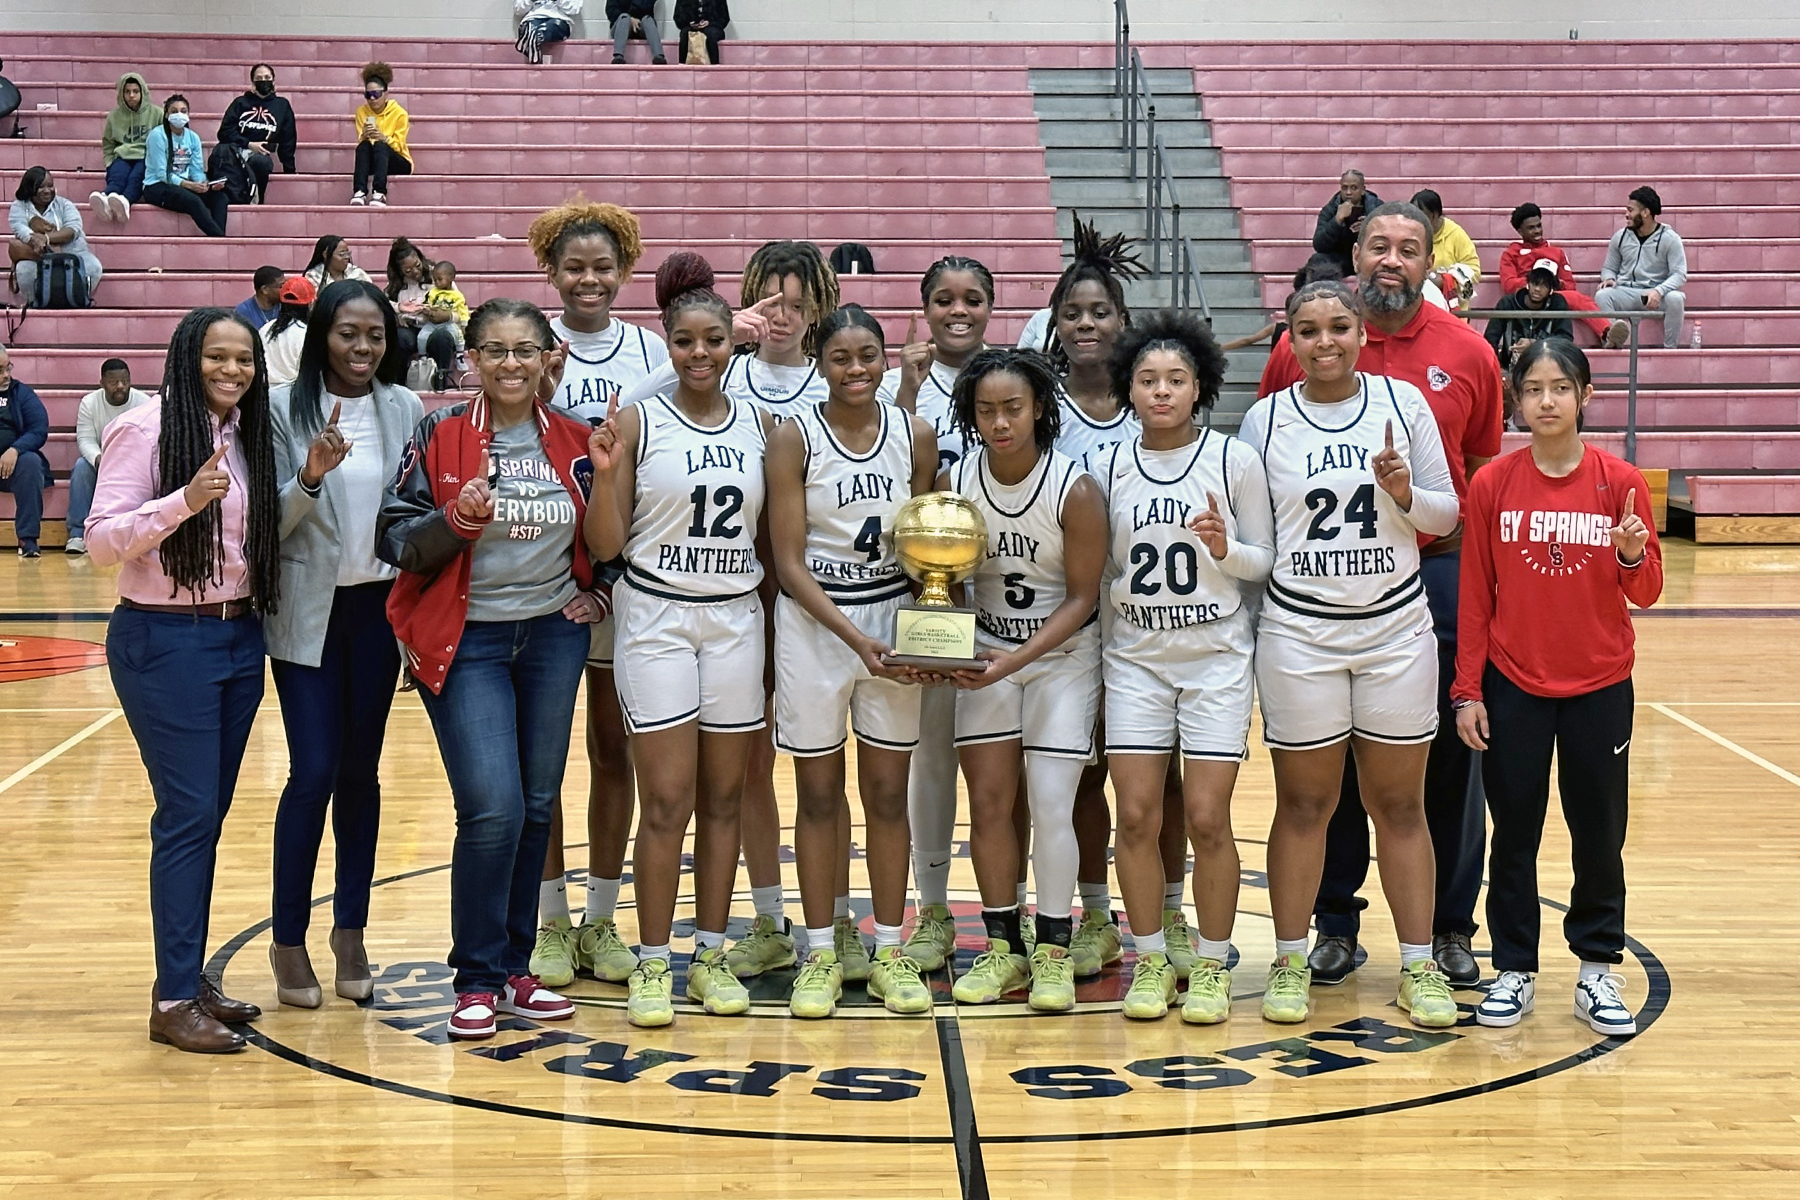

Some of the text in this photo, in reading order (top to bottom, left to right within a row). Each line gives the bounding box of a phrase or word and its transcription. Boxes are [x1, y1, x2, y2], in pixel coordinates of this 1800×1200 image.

[565, 377, 622, 410] LADY
[500, 457, 562, 485] SPRING
[685, 444, 746, 476] LADY
[1306, 443, 1369, 480] LADY
[836, 472, 894, 510] LADY
[493, 497, 576, 526] ERYBODY
[687, 484, 744, 540] 12
[1132, 497, 1192, 533] LADY
[1304, 483, 1378, 541] 24
[509, 524, 542, 541] #STP
[853, 515, 883, 563] 4
[1500, 510, 1613, 547] CY SPRINGS
[657, 543, 755, 574] PANTHERS
[986, 531, 1040, 564] LADY
[1290, 546, 1396, 577] PANTHERS
[1130, 541, 1198, 596] 20
[1000, 572, 1036, 610] 5
[980, 607, 1048, 639] PANTH
[1120, 602, 1220, 631] PANTHERS
